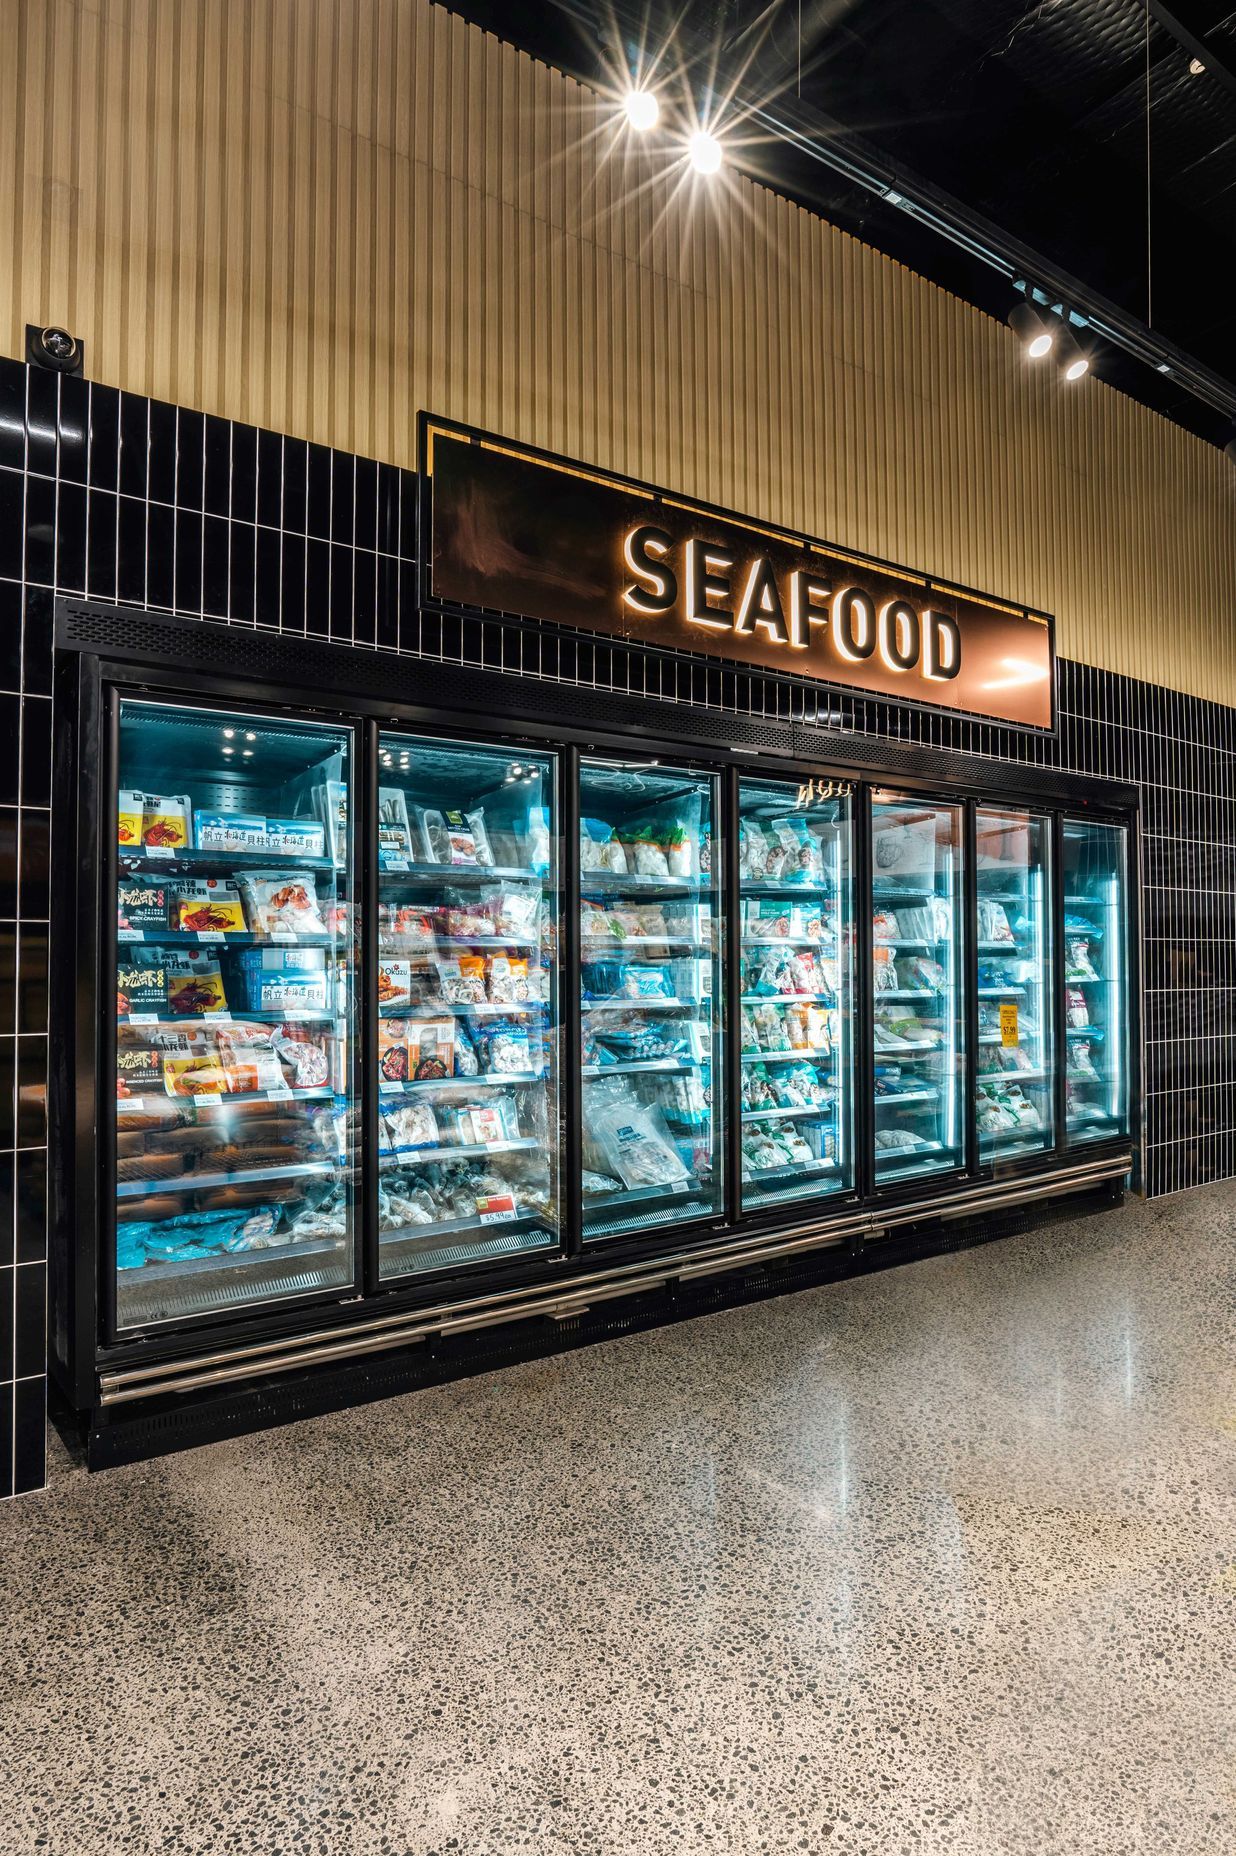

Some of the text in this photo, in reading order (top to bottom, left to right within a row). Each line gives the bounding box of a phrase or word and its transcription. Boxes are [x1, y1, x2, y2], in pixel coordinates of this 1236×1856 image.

[623, 525, 962, 682] SEAFOOD
[384, 966, 408, 976] Okuzu
[485, 1211, 505, 1222] $5.99
